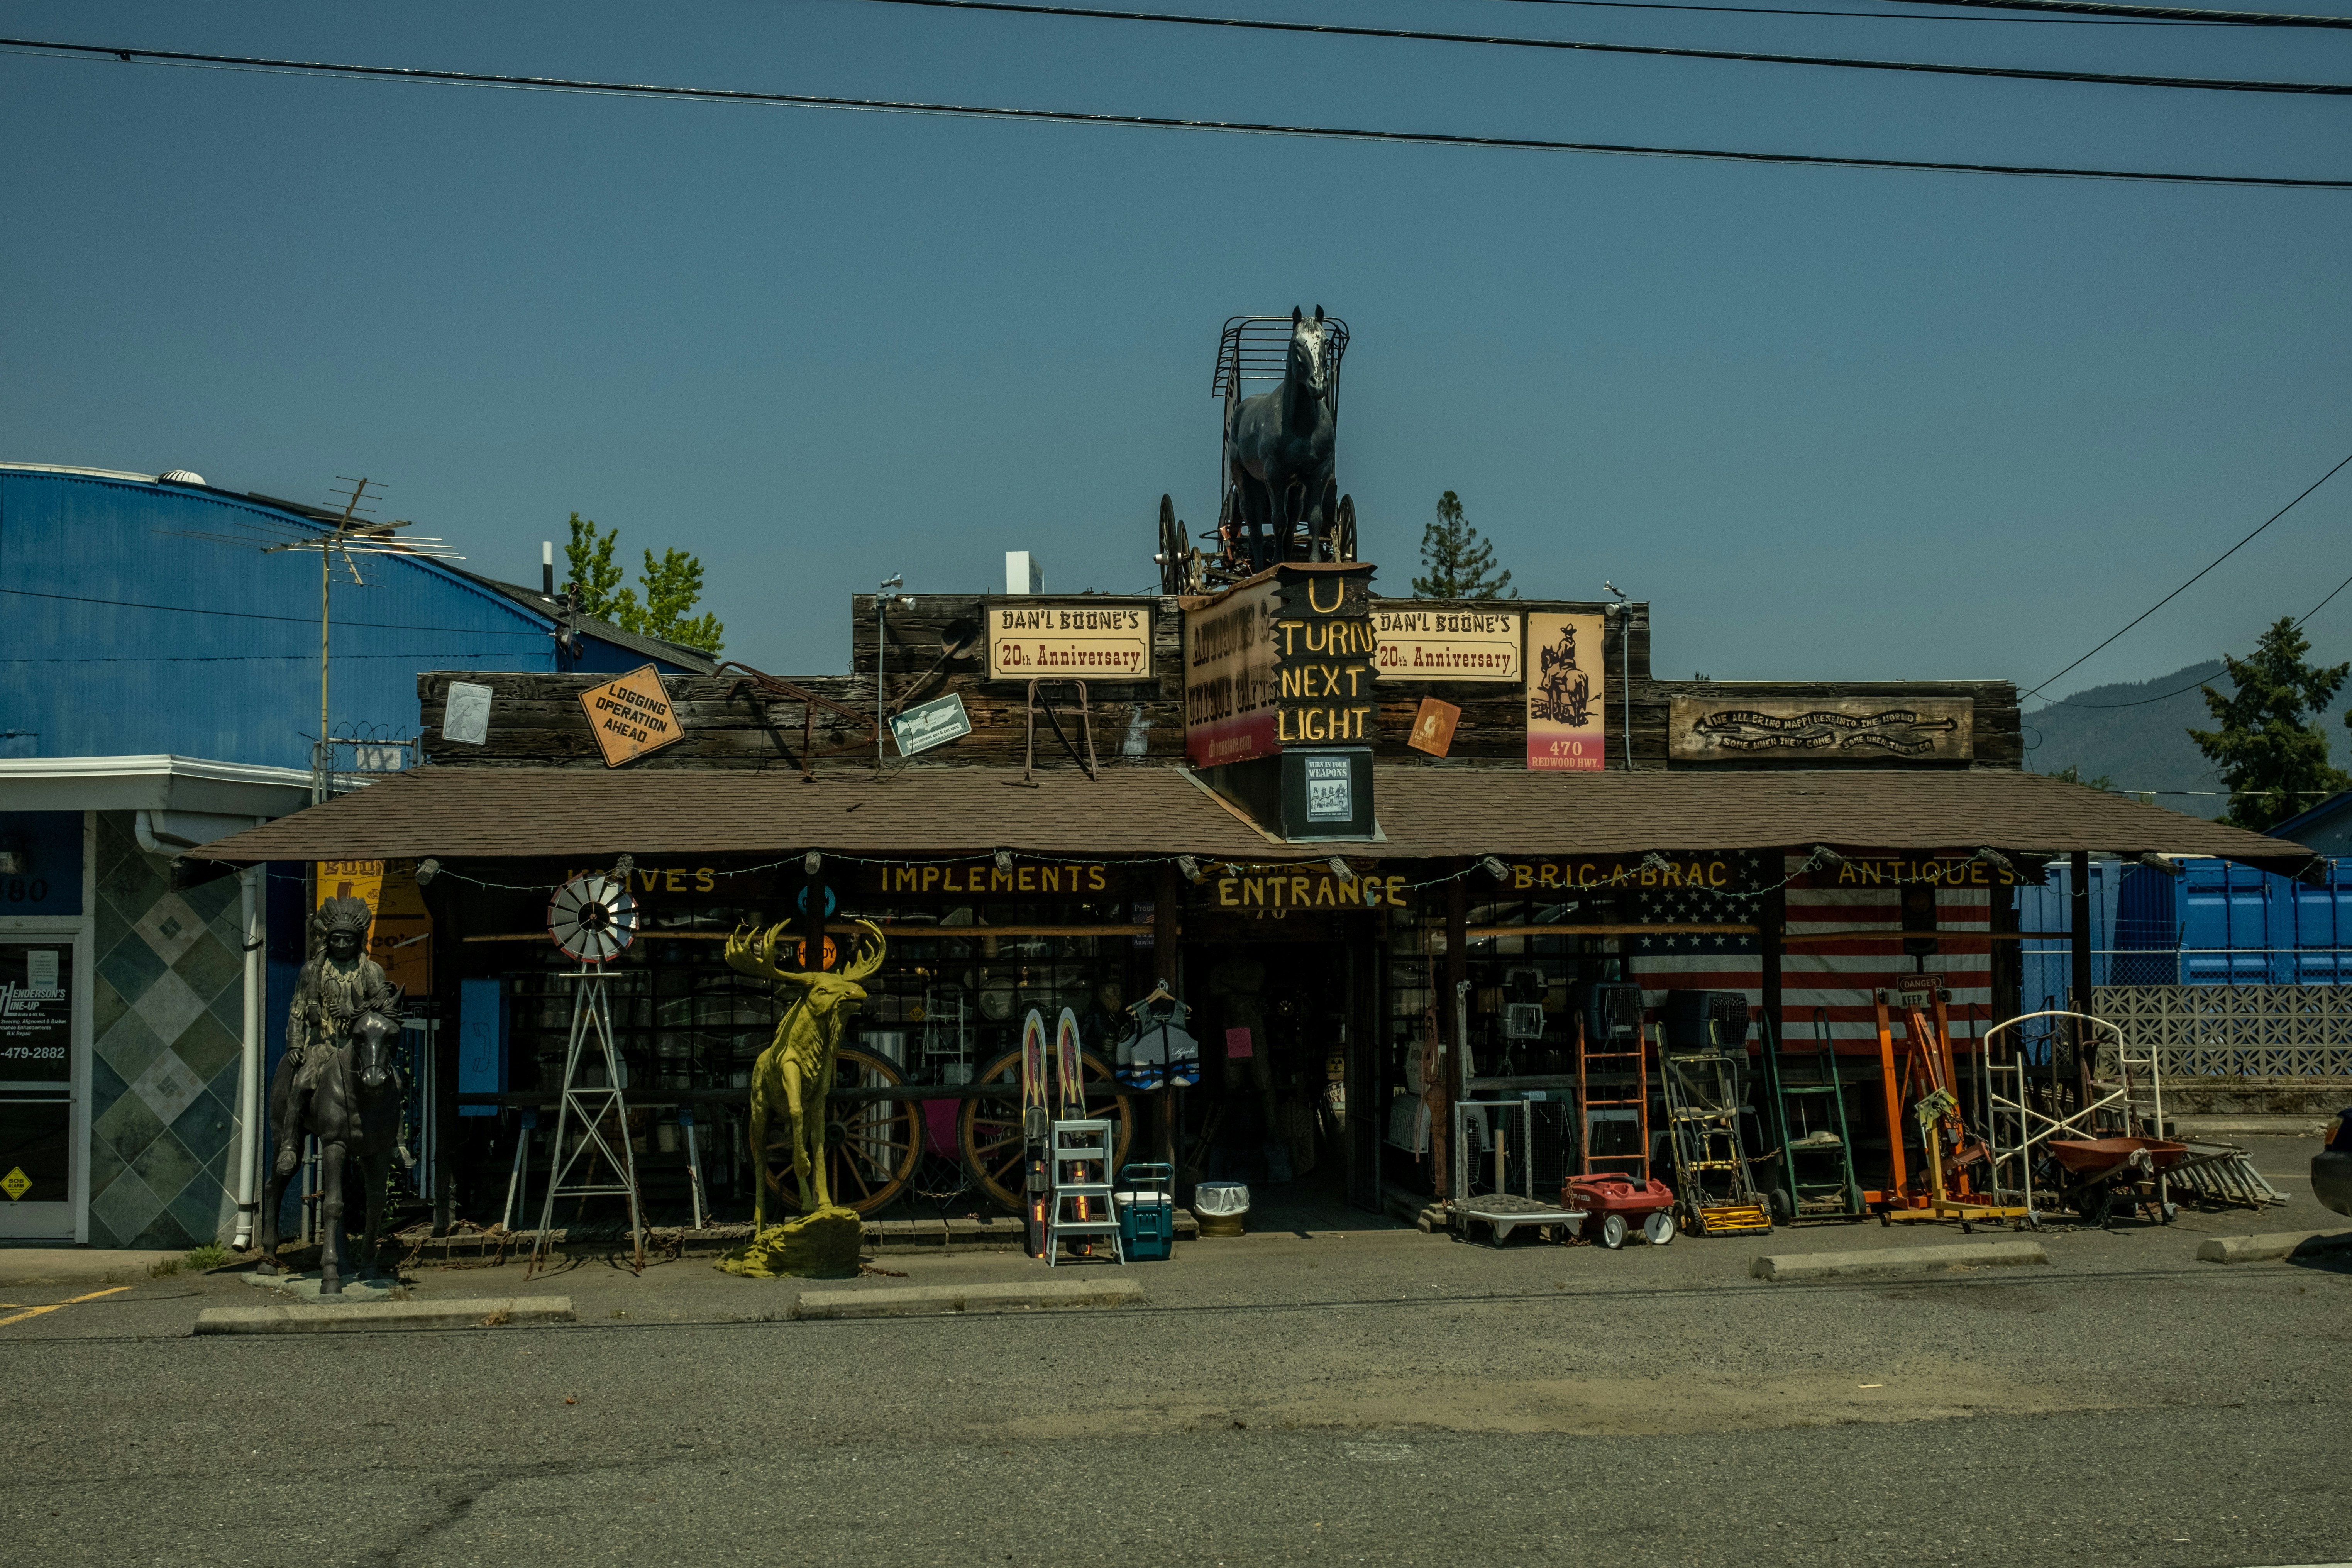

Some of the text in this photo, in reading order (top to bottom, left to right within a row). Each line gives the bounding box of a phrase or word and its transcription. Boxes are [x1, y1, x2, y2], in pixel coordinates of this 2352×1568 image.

[1309, 577, 1344, 613] U
[1002, 610, 1139, 630] DAN'L BOONE'S
[1194, 599, 1269, 667] ANTIQUES &
[1380, 613, 1510, 633] DAN'L BOONE'S
[1278, 621, 1374, 656] TURN
[1003, 644, 1140, 672] 20th Anniversary
[1380, 646, 1511, 674] 20th Anniversary
[1188, 660, 1278, 726] UNIQUE GIFTS
[1282, 664, 1366, 698] NEXT
[608, 684, 667, 716] LOGGING
[596, 696, 668, 733] OPERATION
[1278, 706, 1371, 741] LIGHT
[1732, 713, 1748, 722] ALL
[1752, 714, 1781, 728] BRING
[1860, 718, 1879, 728] THE
[603, 718, 648, 743] AHEAD
[1723, 737, 1749, 749] SOME
[1780, 737, 1802, 747] THEY
[1807, 734, 1831, 748] COME
[1550, 741, 1582, 756] 470
[1532, 757, 1600, 768] REDWOOD HWY.
[882, 865, 1106, 892] IMPLEMENTS
[1838, 860, 2015, 886] ANTIQUES
[1218, 876, 1407, 907] ENTRANCE
[1905, 979, 1936, 988] DANGER
[1902, 995, 1922, 1006] KEEP
